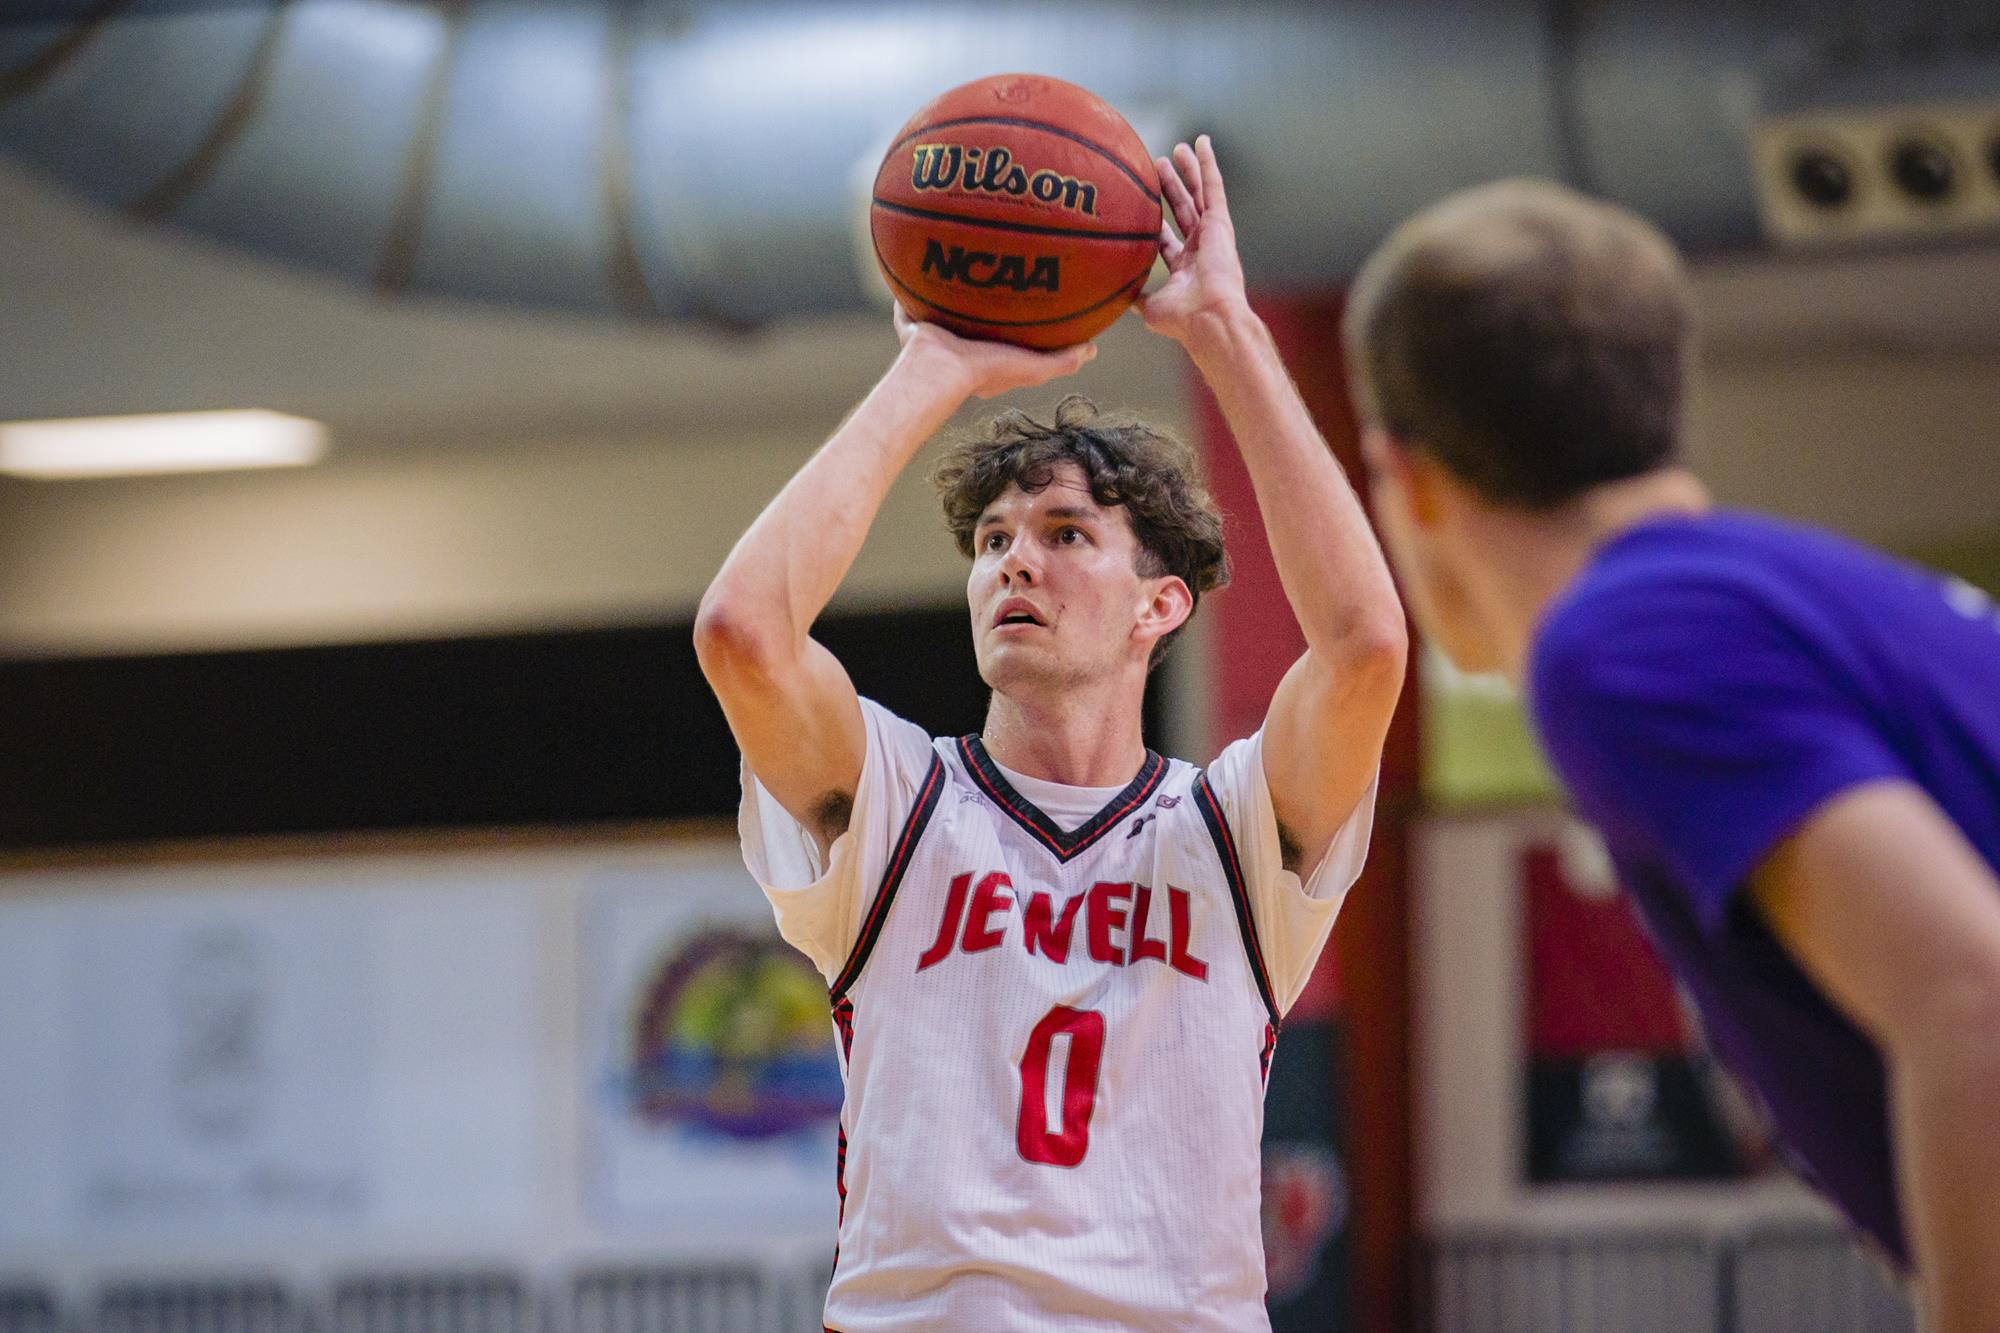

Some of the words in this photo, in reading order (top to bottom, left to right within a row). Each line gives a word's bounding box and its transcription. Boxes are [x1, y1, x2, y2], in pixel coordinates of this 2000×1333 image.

[911, 143, 1097, 217] Wilson
[920, 236, 1060, 293] NCAA
[916, 870, 1209, 984] JEWELL
[1015, 1003, 1107, 1169] 0
